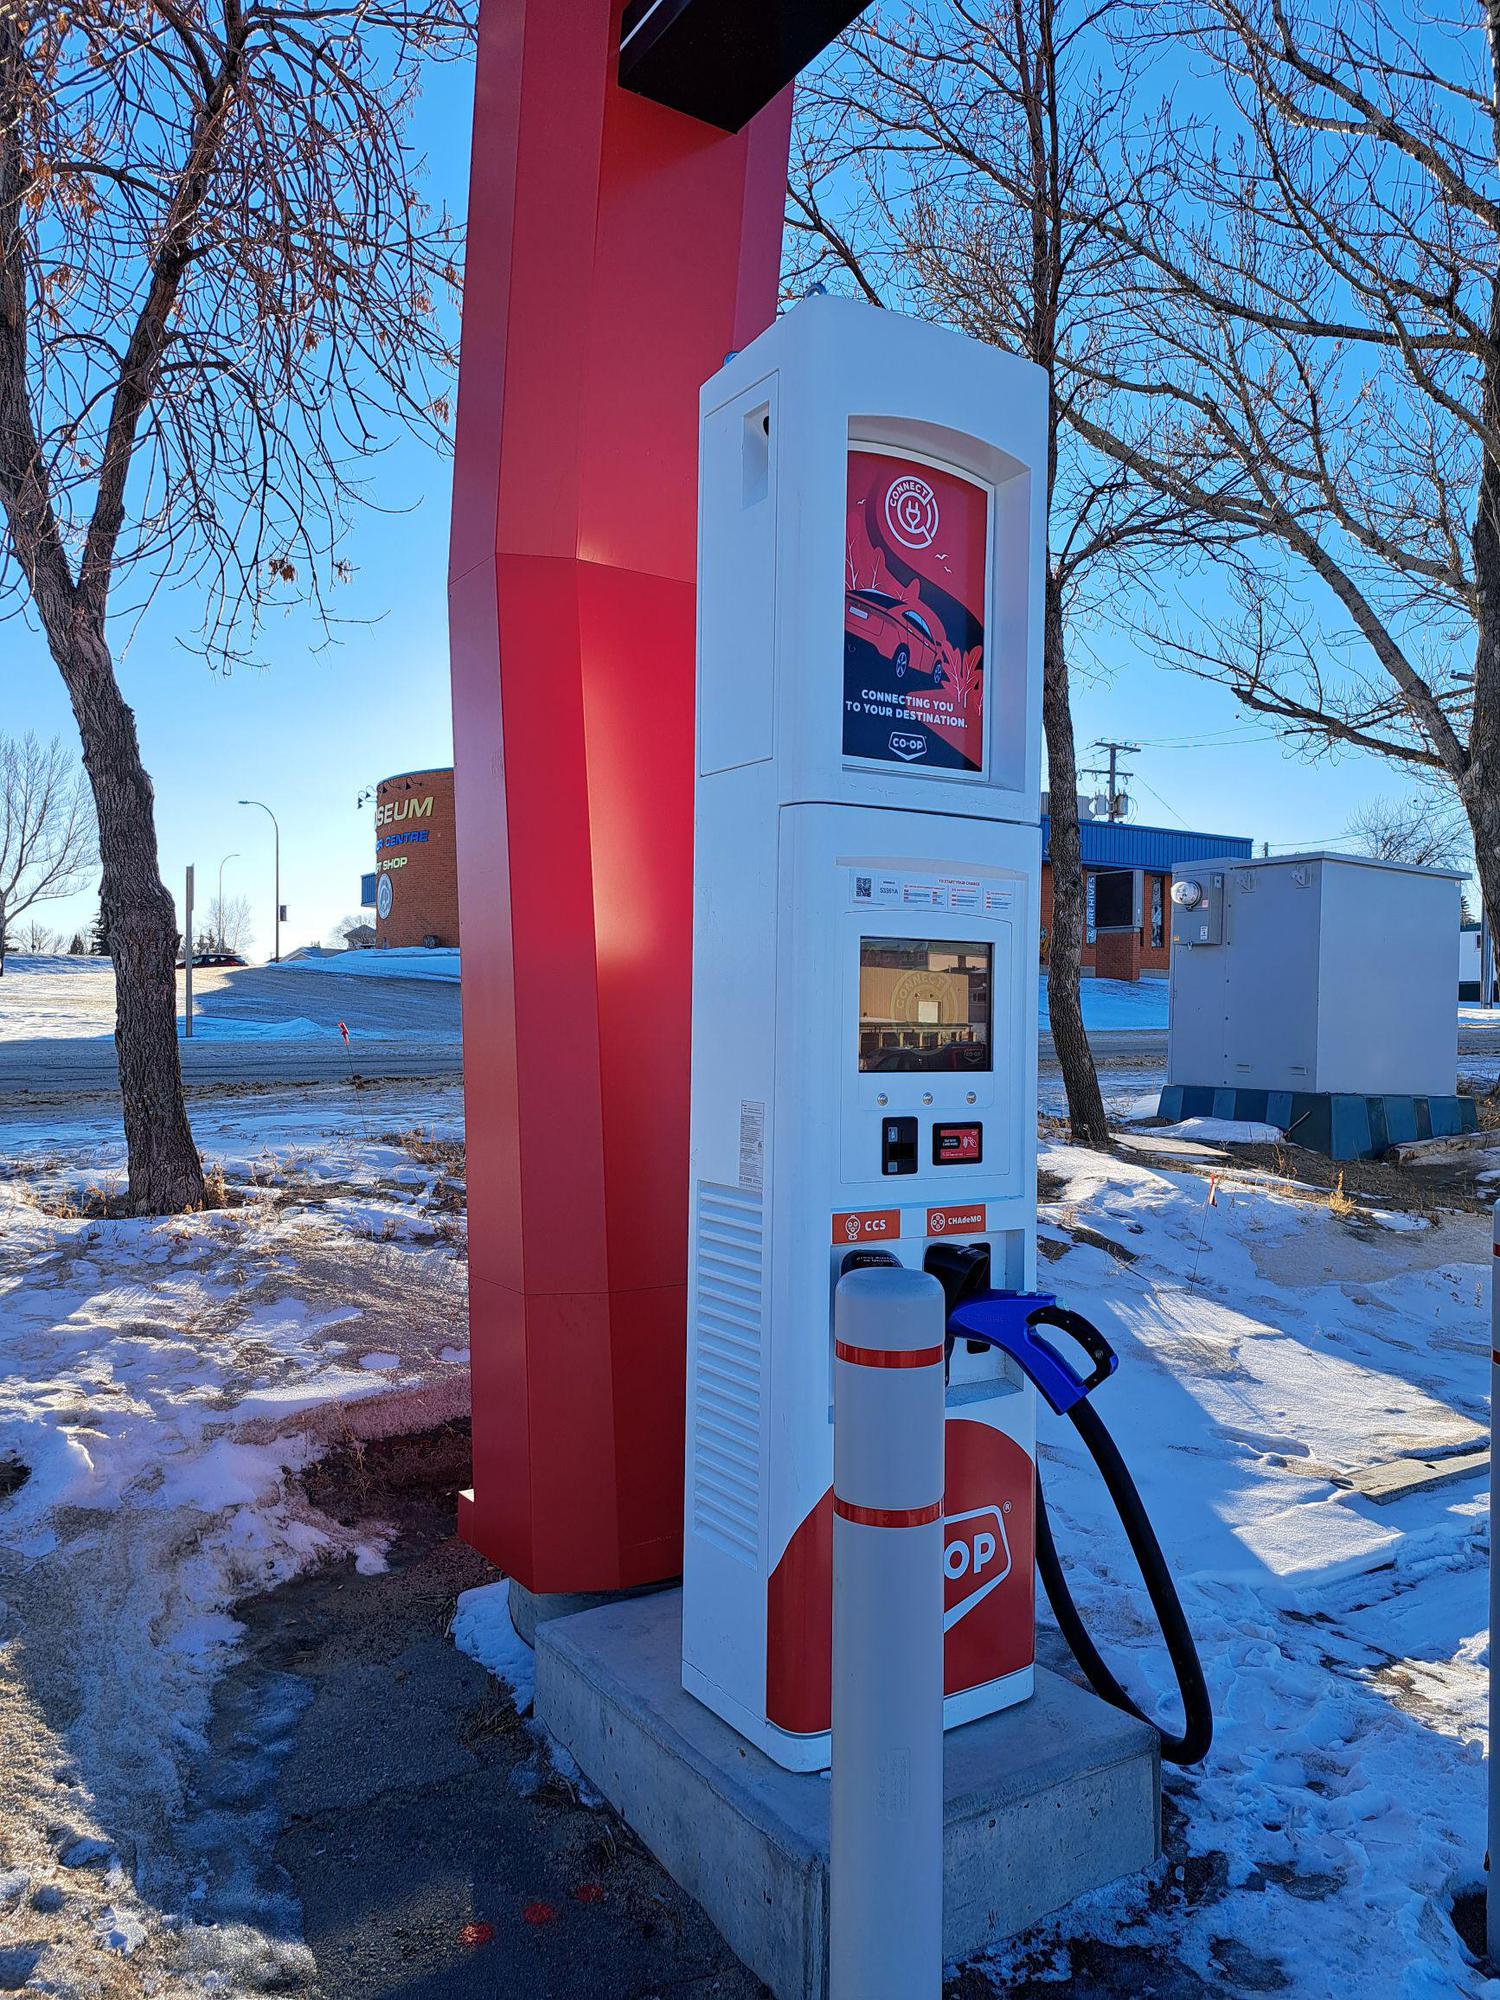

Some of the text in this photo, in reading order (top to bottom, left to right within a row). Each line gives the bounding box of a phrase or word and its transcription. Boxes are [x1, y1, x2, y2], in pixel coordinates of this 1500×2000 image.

[889, 481, 928, 507] CONNECT
[861, 689, 954, 712] CONNECTING YOU
[845, 701, 968, 728] TO YOUR DESTINATION.
[892, 737, 923, 750] CO-OP
[374, 796, 434, 827] SEUM
[385, 830, 430, 847] CENTRE
[382, 856, 408, 871] SHOP
[864, 1218, 887, 1232] CCS
[947, 1214, 982, 1225] CHAdeMO
